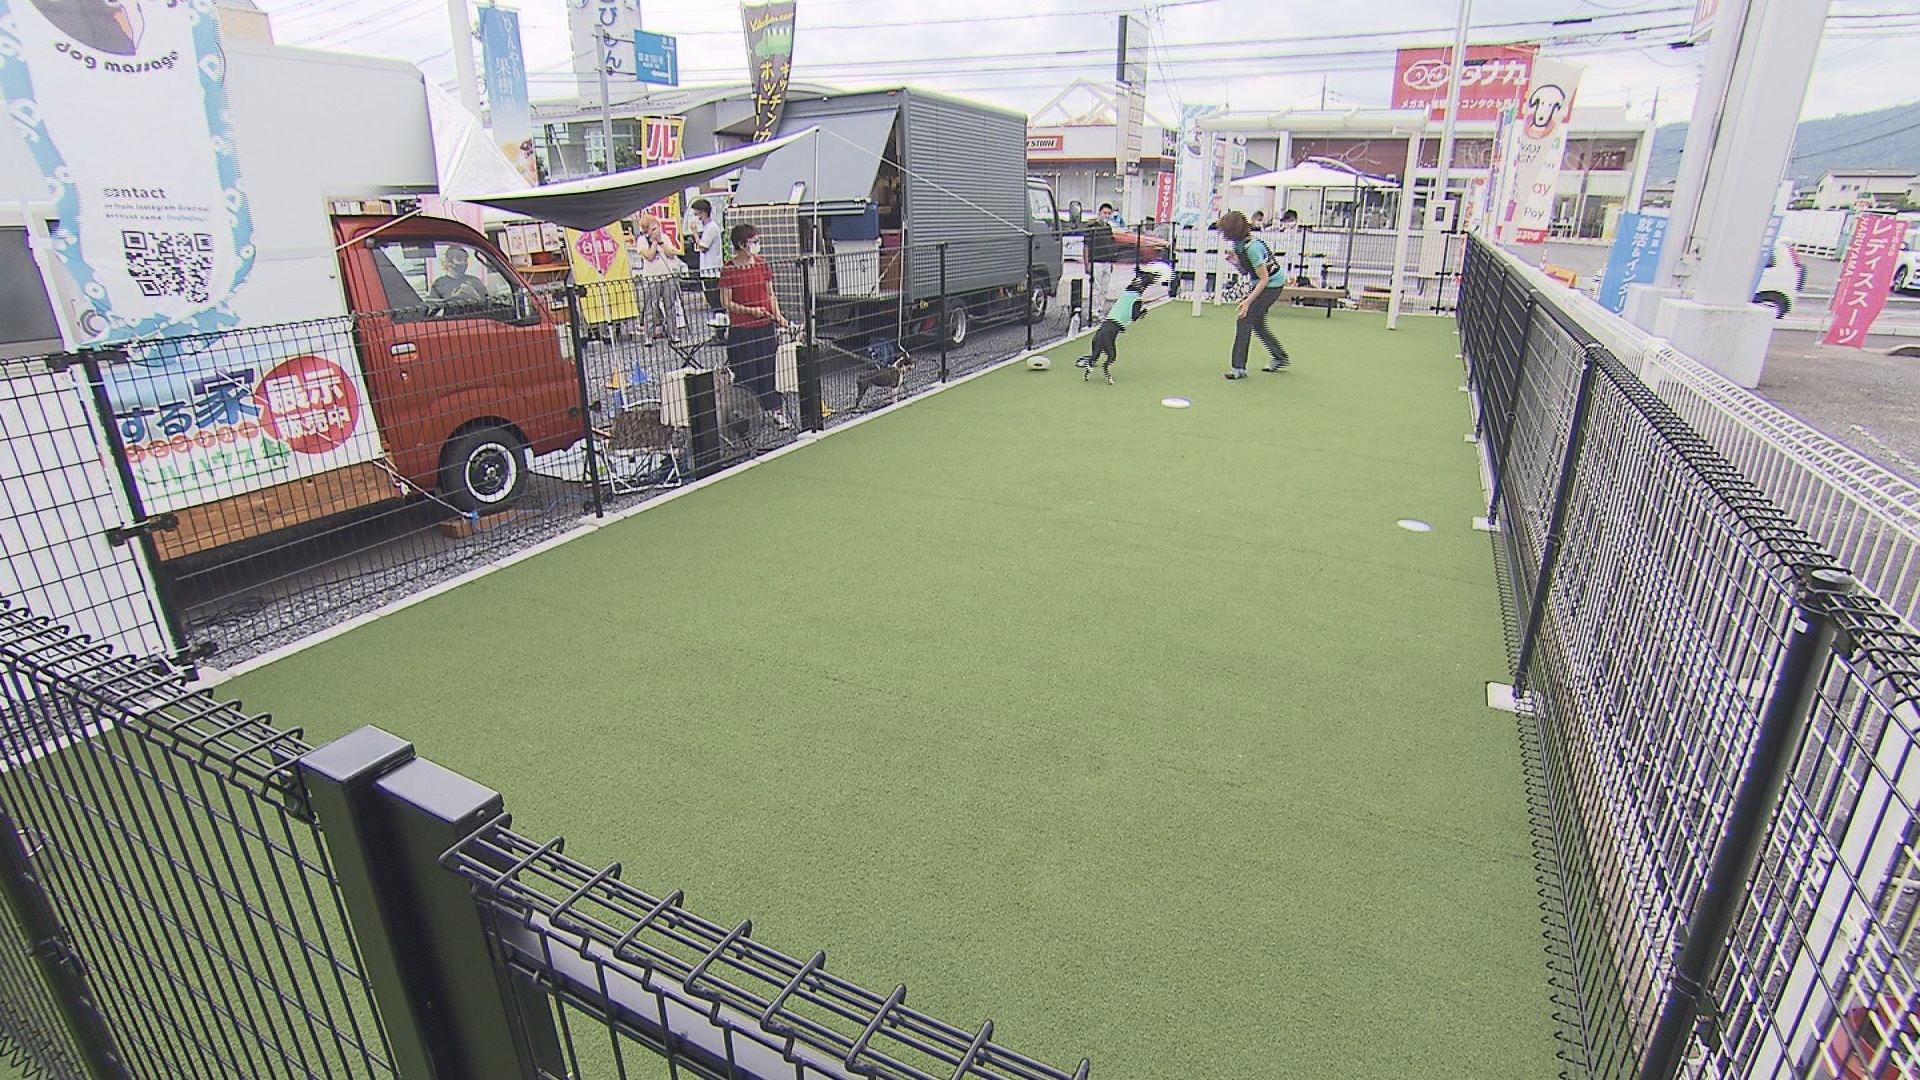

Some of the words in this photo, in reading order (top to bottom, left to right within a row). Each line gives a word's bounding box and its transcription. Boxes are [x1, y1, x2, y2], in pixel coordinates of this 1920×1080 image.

[54, 41, 98, 70] dog
[104, 50, 180, 74] massage
[1459, 59, 1527, 87] タナカ
[1843, 216, 1870, 278] HARUYAMA
[1838, 218, 1892, 344] レディススーツ
[266, 367, 345, 413] 展示
